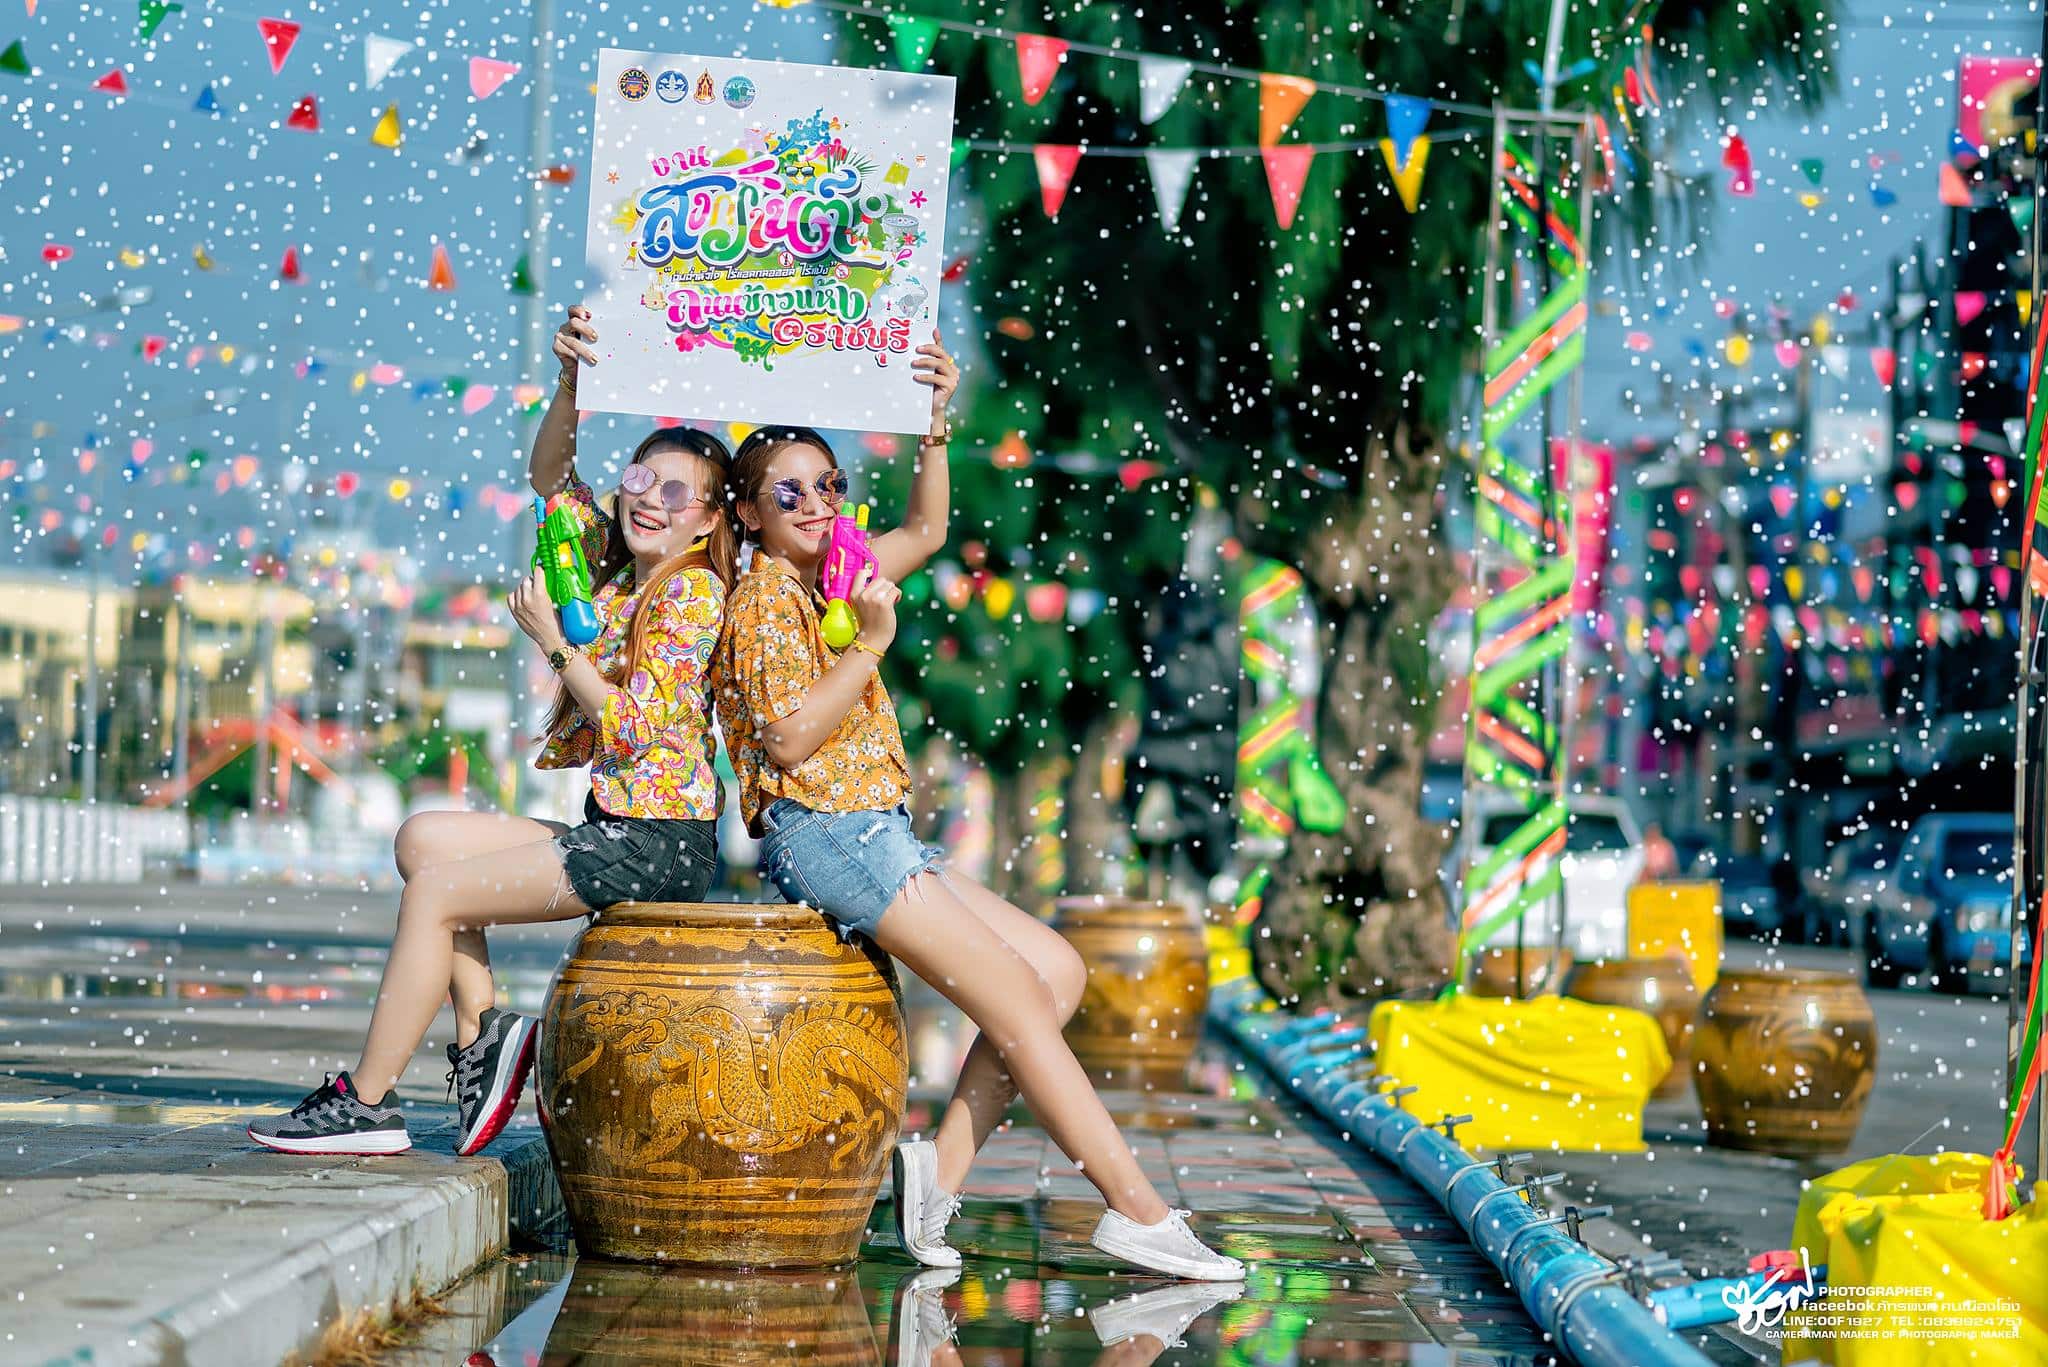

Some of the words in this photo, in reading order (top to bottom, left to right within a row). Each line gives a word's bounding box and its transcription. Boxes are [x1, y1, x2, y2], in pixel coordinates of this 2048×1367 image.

[652, 145, 712, 177] งาน
[638, 157, 866, 267] สงกรานต์
[773, 317, 912, 365] @ราชบุรี
